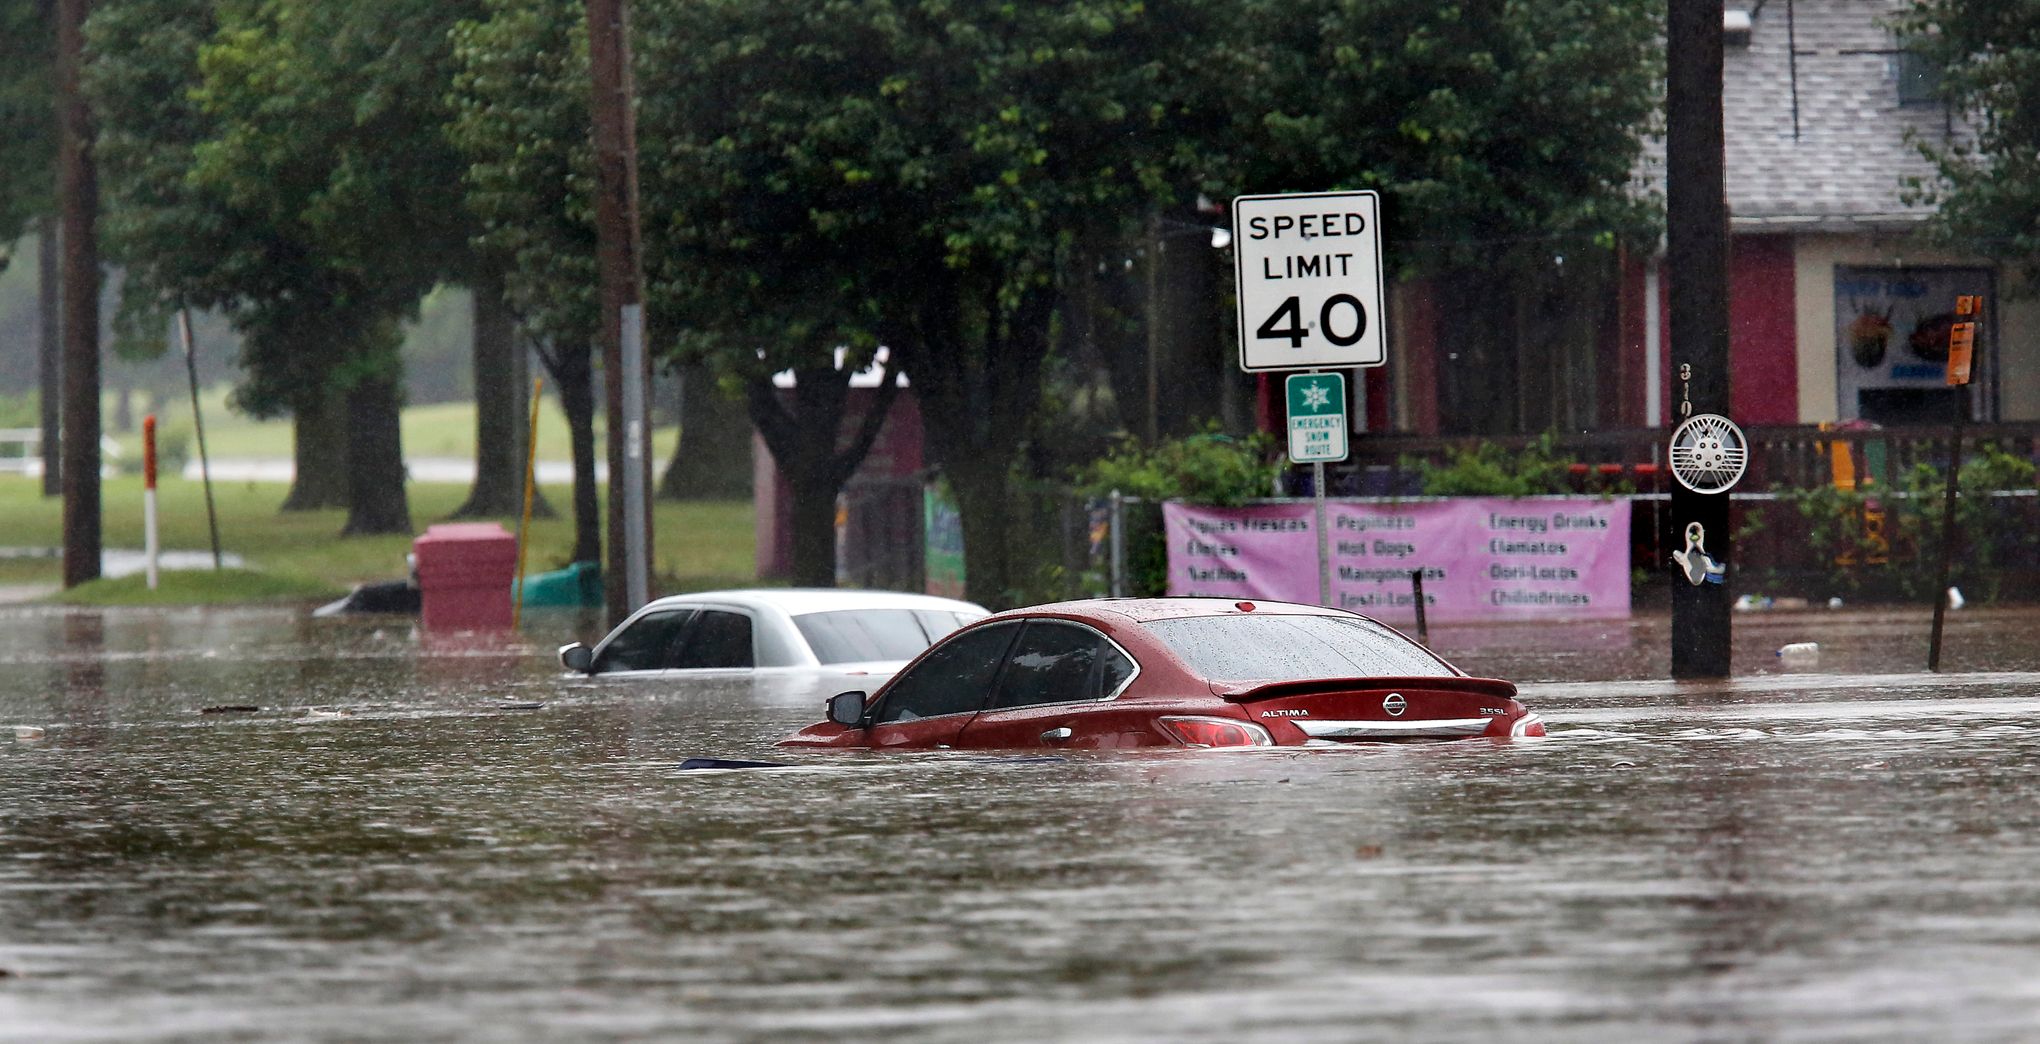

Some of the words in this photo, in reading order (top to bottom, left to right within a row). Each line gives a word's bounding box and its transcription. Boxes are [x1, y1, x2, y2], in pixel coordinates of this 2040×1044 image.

[1249, 213, 1365, 240] SPEED
[1264, 253, 1353, 279] LIMIT
[1256, 293, 1367, 348] 40
[1292, 417, 1341, 429] EMERGENCY
[1305, 431, 1329, 442] SNOW
[1304, 444, 1331, 455] ROUTE
[1489, 513, 1547, 533] Energy
[1552, 513, 1607, 529] Drinks
[1337, 542, 1366, 554] Hot
[1373, 540, 1415, 558] Dogs
[1261, 709, 1310, 718] ALTIMA
